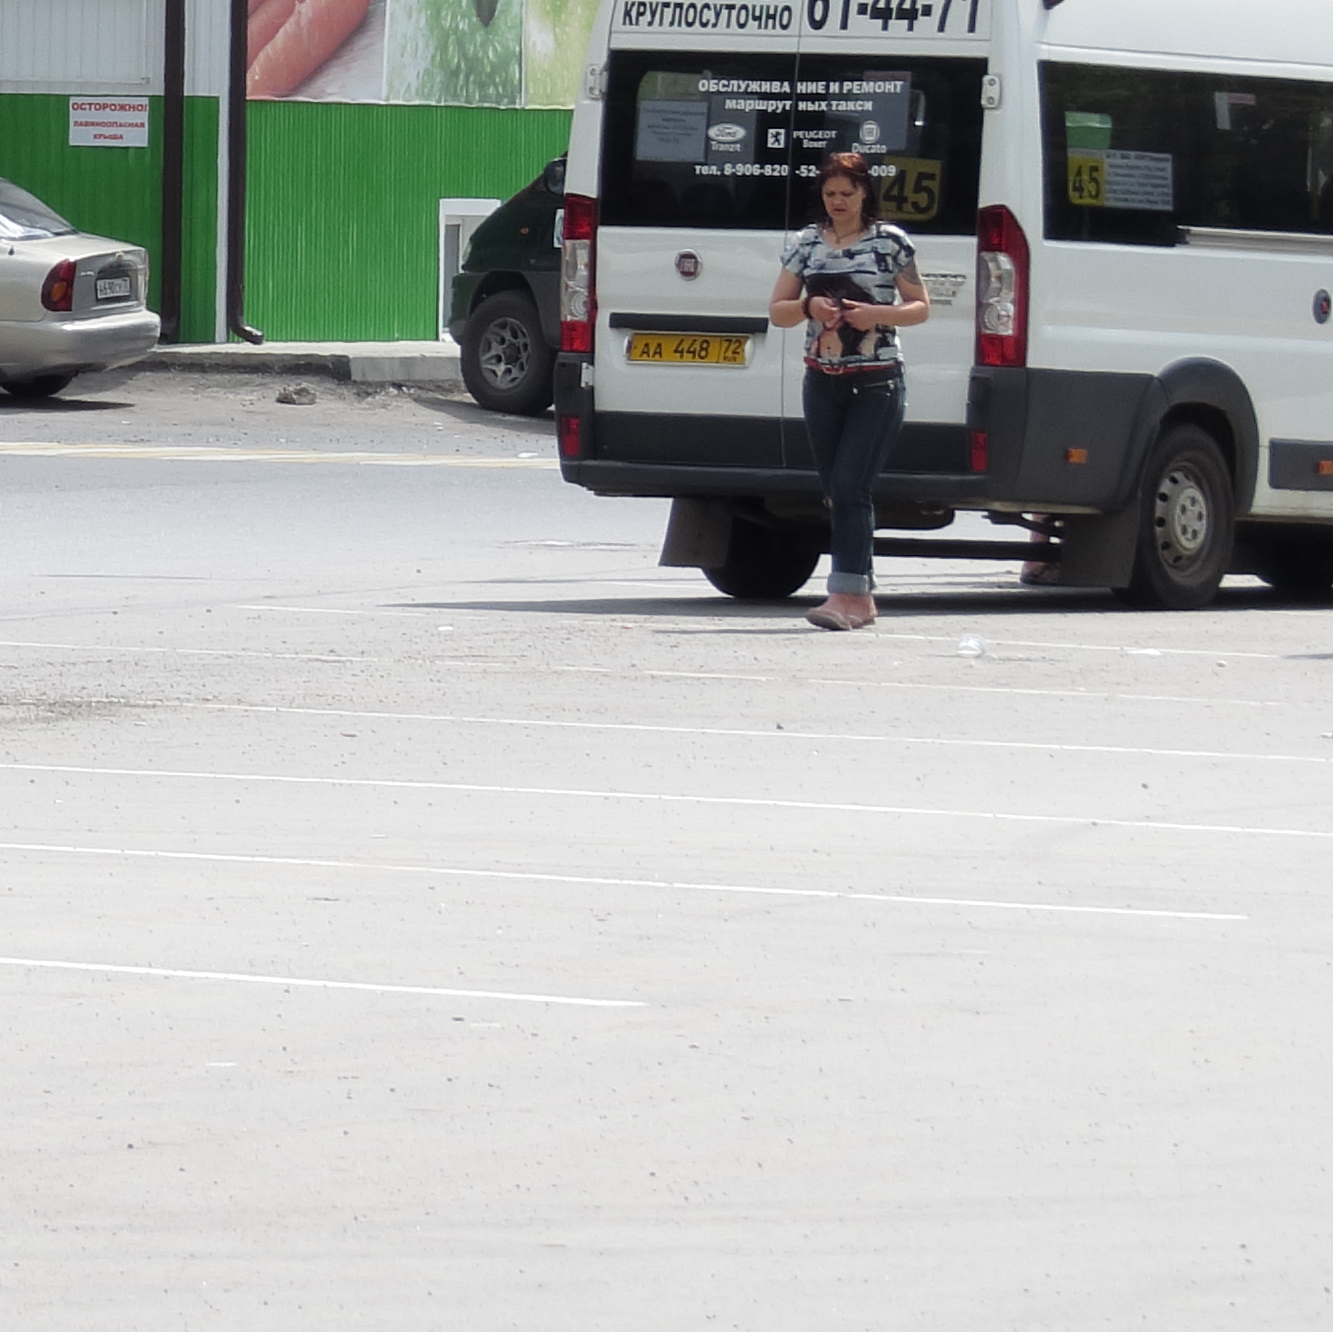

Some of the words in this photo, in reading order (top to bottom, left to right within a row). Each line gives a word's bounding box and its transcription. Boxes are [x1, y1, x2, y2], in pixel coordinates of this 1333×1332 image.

[622, 1, 793, 30] КРУГЛОСУТОЧНО
[829, 81, 840, 93] И
[843, 81, 904, 94] РЕМОНТ
[71, 102, 148, 112] ОСТОРОЖНО!
[832, 100, 873, 111] такси
[793, 130, 837, 139] PEUGEOT
[851, 143, 887, 154] Ducato
[694, 165, 721, 176] тел.
[1072, 165, 1101, 200] 45
[882, 168, 937, 214] 45
[639, 342, 663, 358] АА
[674, 338, 710, 360] 448
[723, 339, 742, 355] 72
